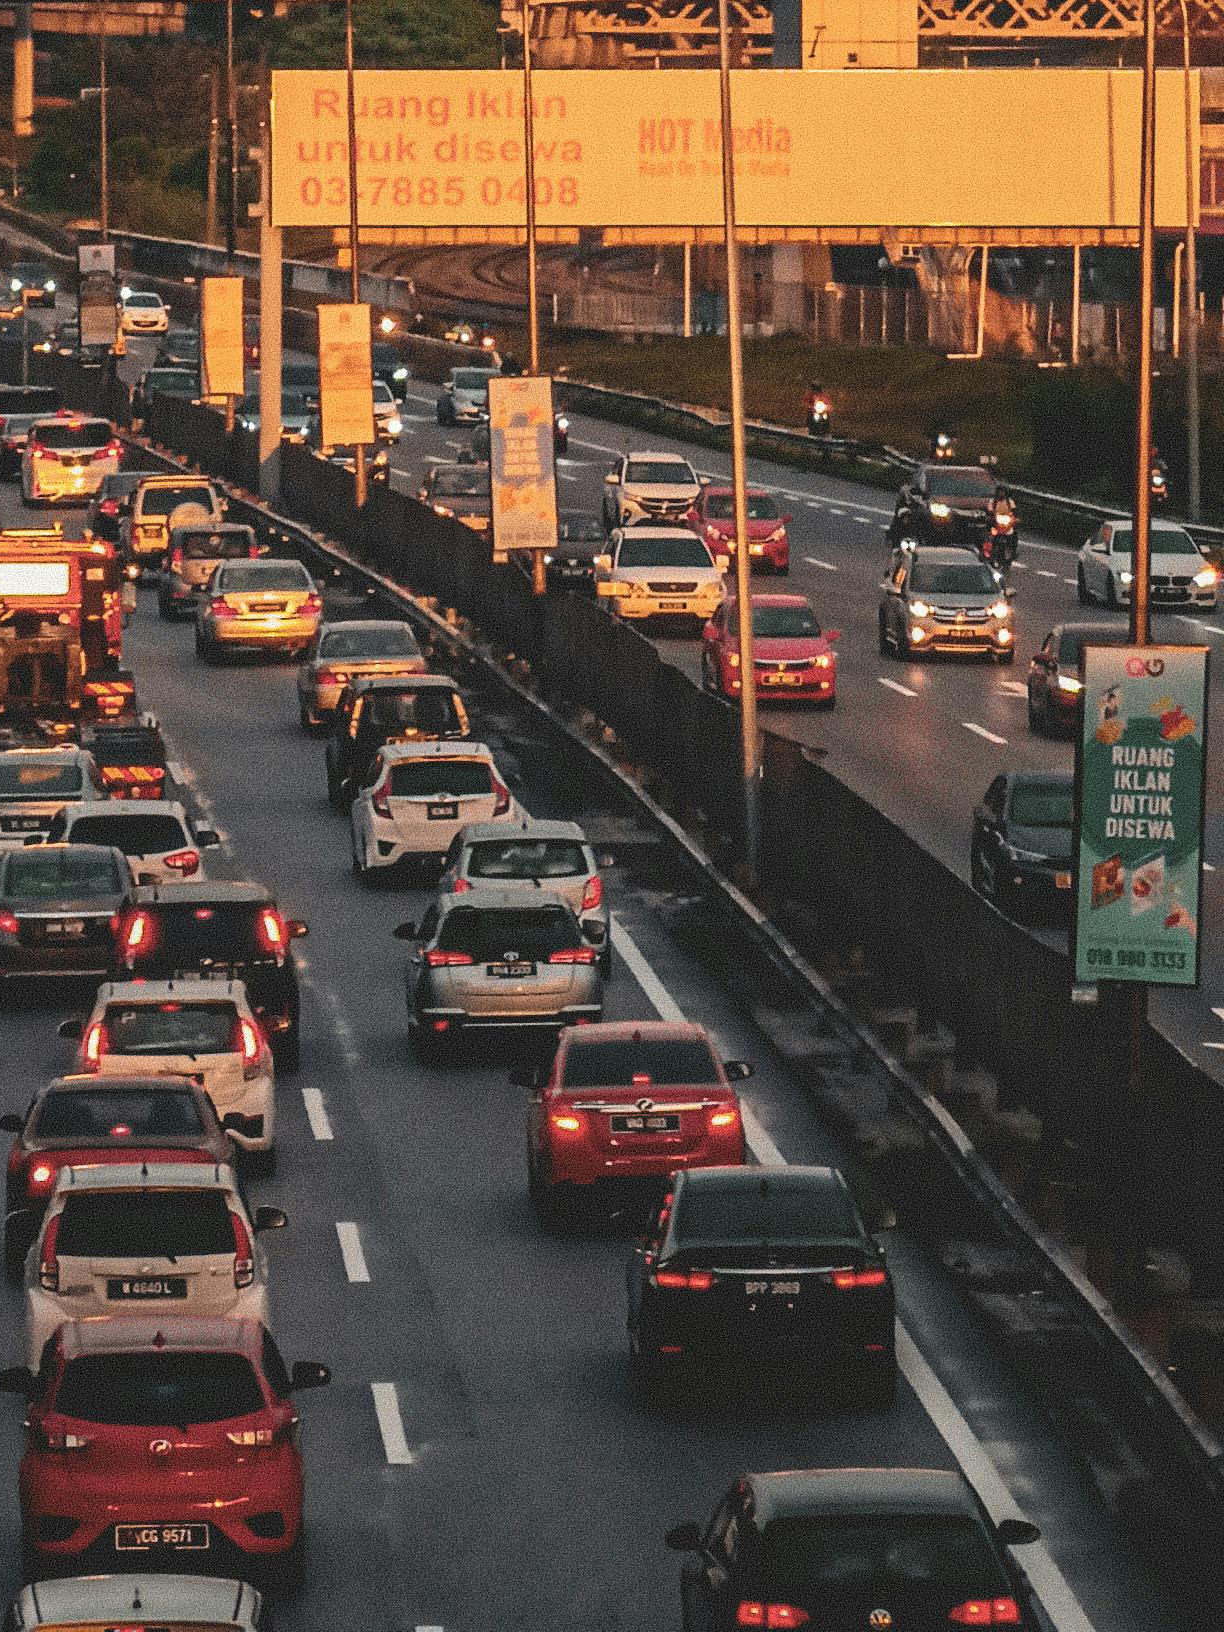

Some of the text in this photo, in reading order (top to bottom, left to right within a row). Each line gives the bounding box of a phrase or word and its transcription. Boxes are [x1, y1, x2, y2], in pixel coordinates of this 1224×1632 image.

[313, 88, 567, 126] Ruang Iklan
[297, 133, 583, 163] untuk disewa
[637, 118, 695, 155] HOT
[300, 176, 580, 207] 03-7885 0408
[1111, 745, 1176, 769] RUANG
[1114, 769, 1172, 793] IKLAN
[1110, 793, 1174, 817] UNTUK
[1105, 817, 1176, 841] DISEWA
[162, 1529, 193, 1544] 9571
